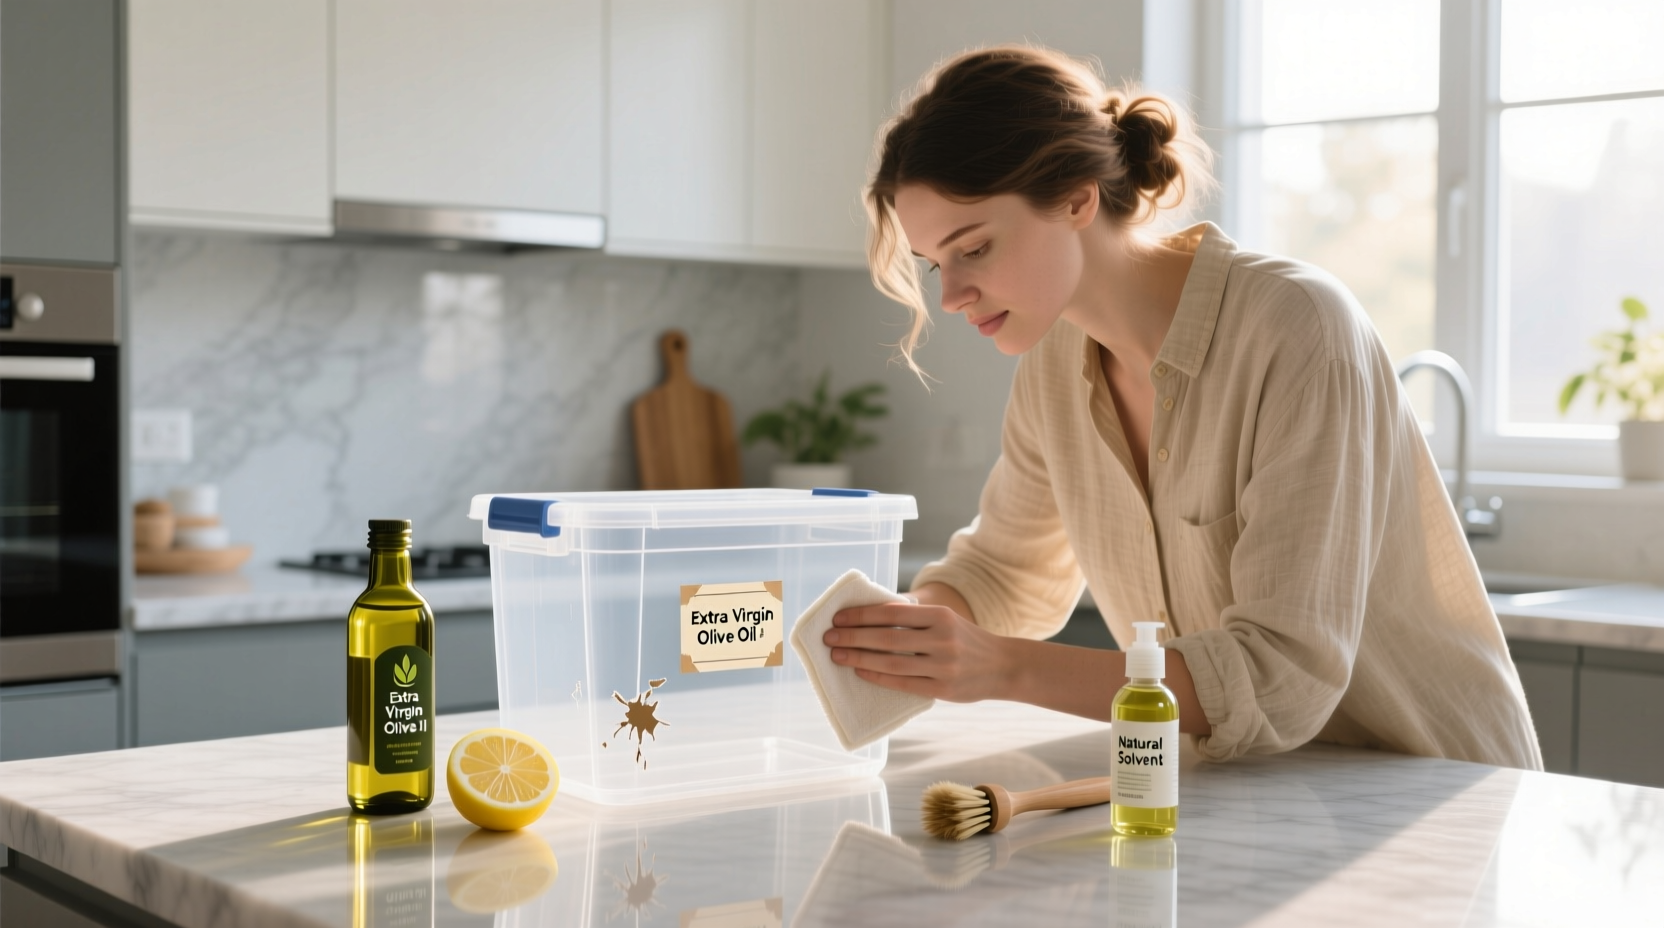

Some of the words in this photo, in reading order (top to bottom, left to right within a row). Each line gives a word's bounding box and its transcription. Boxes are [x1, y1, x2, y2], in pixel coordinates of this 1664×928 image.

[691, 610, 728, 625] Extra
[732, 606, 774, 626] Virgin
[697, 628, 734, 645] Olive
[1118, 735, 1163, 750] Natural
[1118, 750, 1163, 766] Solvent
